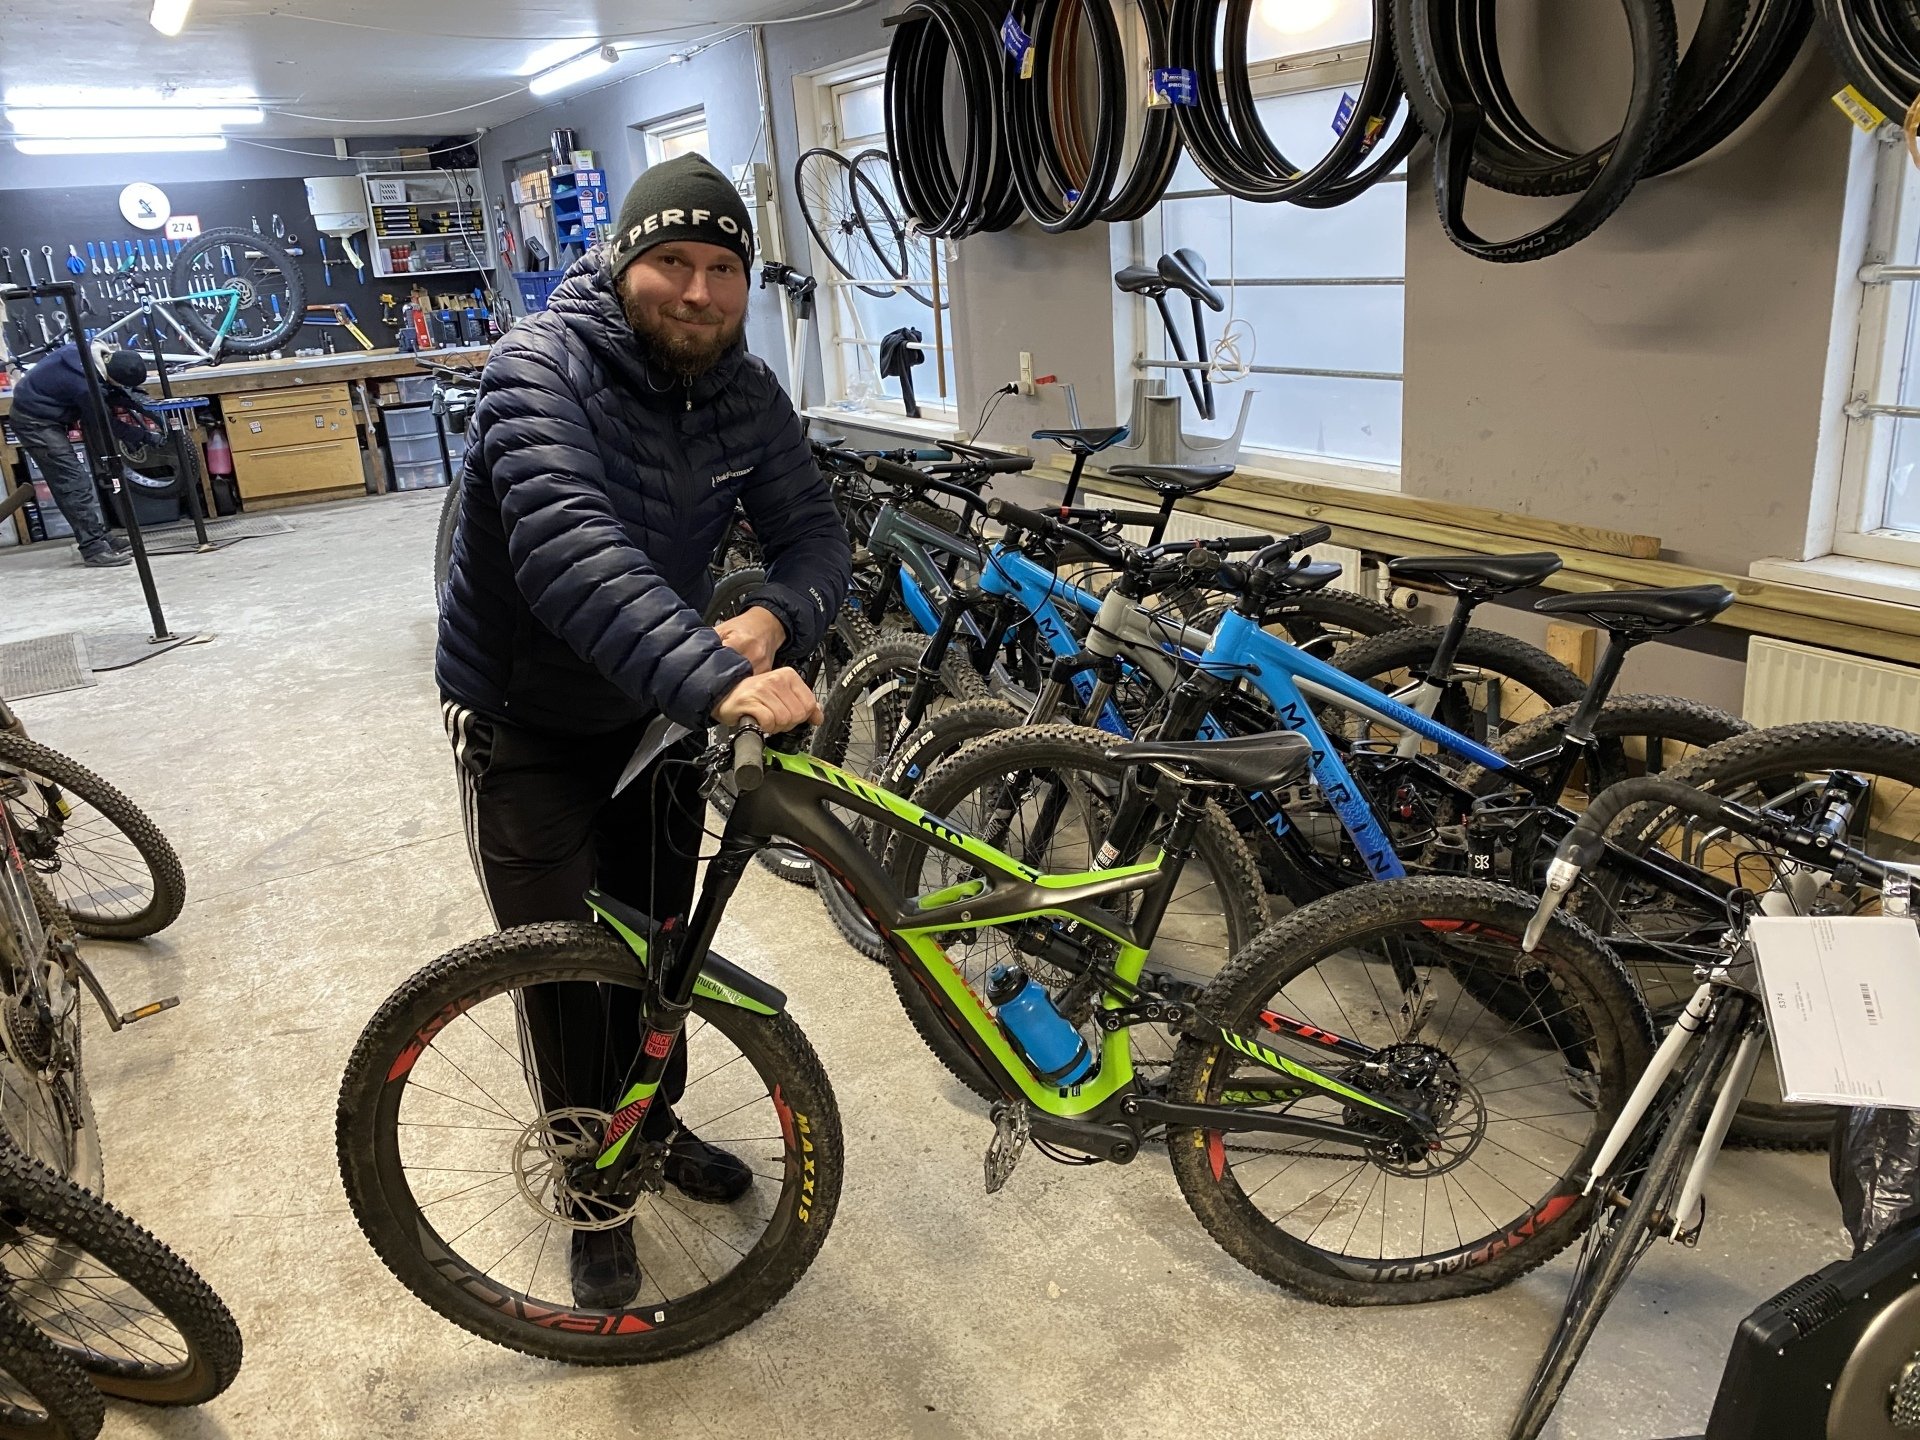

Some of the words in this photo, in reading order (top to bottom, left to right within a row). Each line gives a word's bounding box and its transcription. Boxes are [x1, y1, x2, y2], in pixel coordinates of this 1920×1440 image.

[172, 223, 193, 233] 274
[628, 209, 752, 262] PERFOR
[842, 672, 854, 687] VEE
[852, 659, 868, 675] TIRE
[891, 760, 906, 782] VEE
[902, 741, 922, 763] TIRE
[1279, 702, 1391, 874] MARIN
[1776, 992, 1787, 1009] 5374
[648, 1042, 668, 1057] SHOX
[650, 1031, 672, 1045] ROCK
[795, 1111, 815, 1224] MAXXIS
